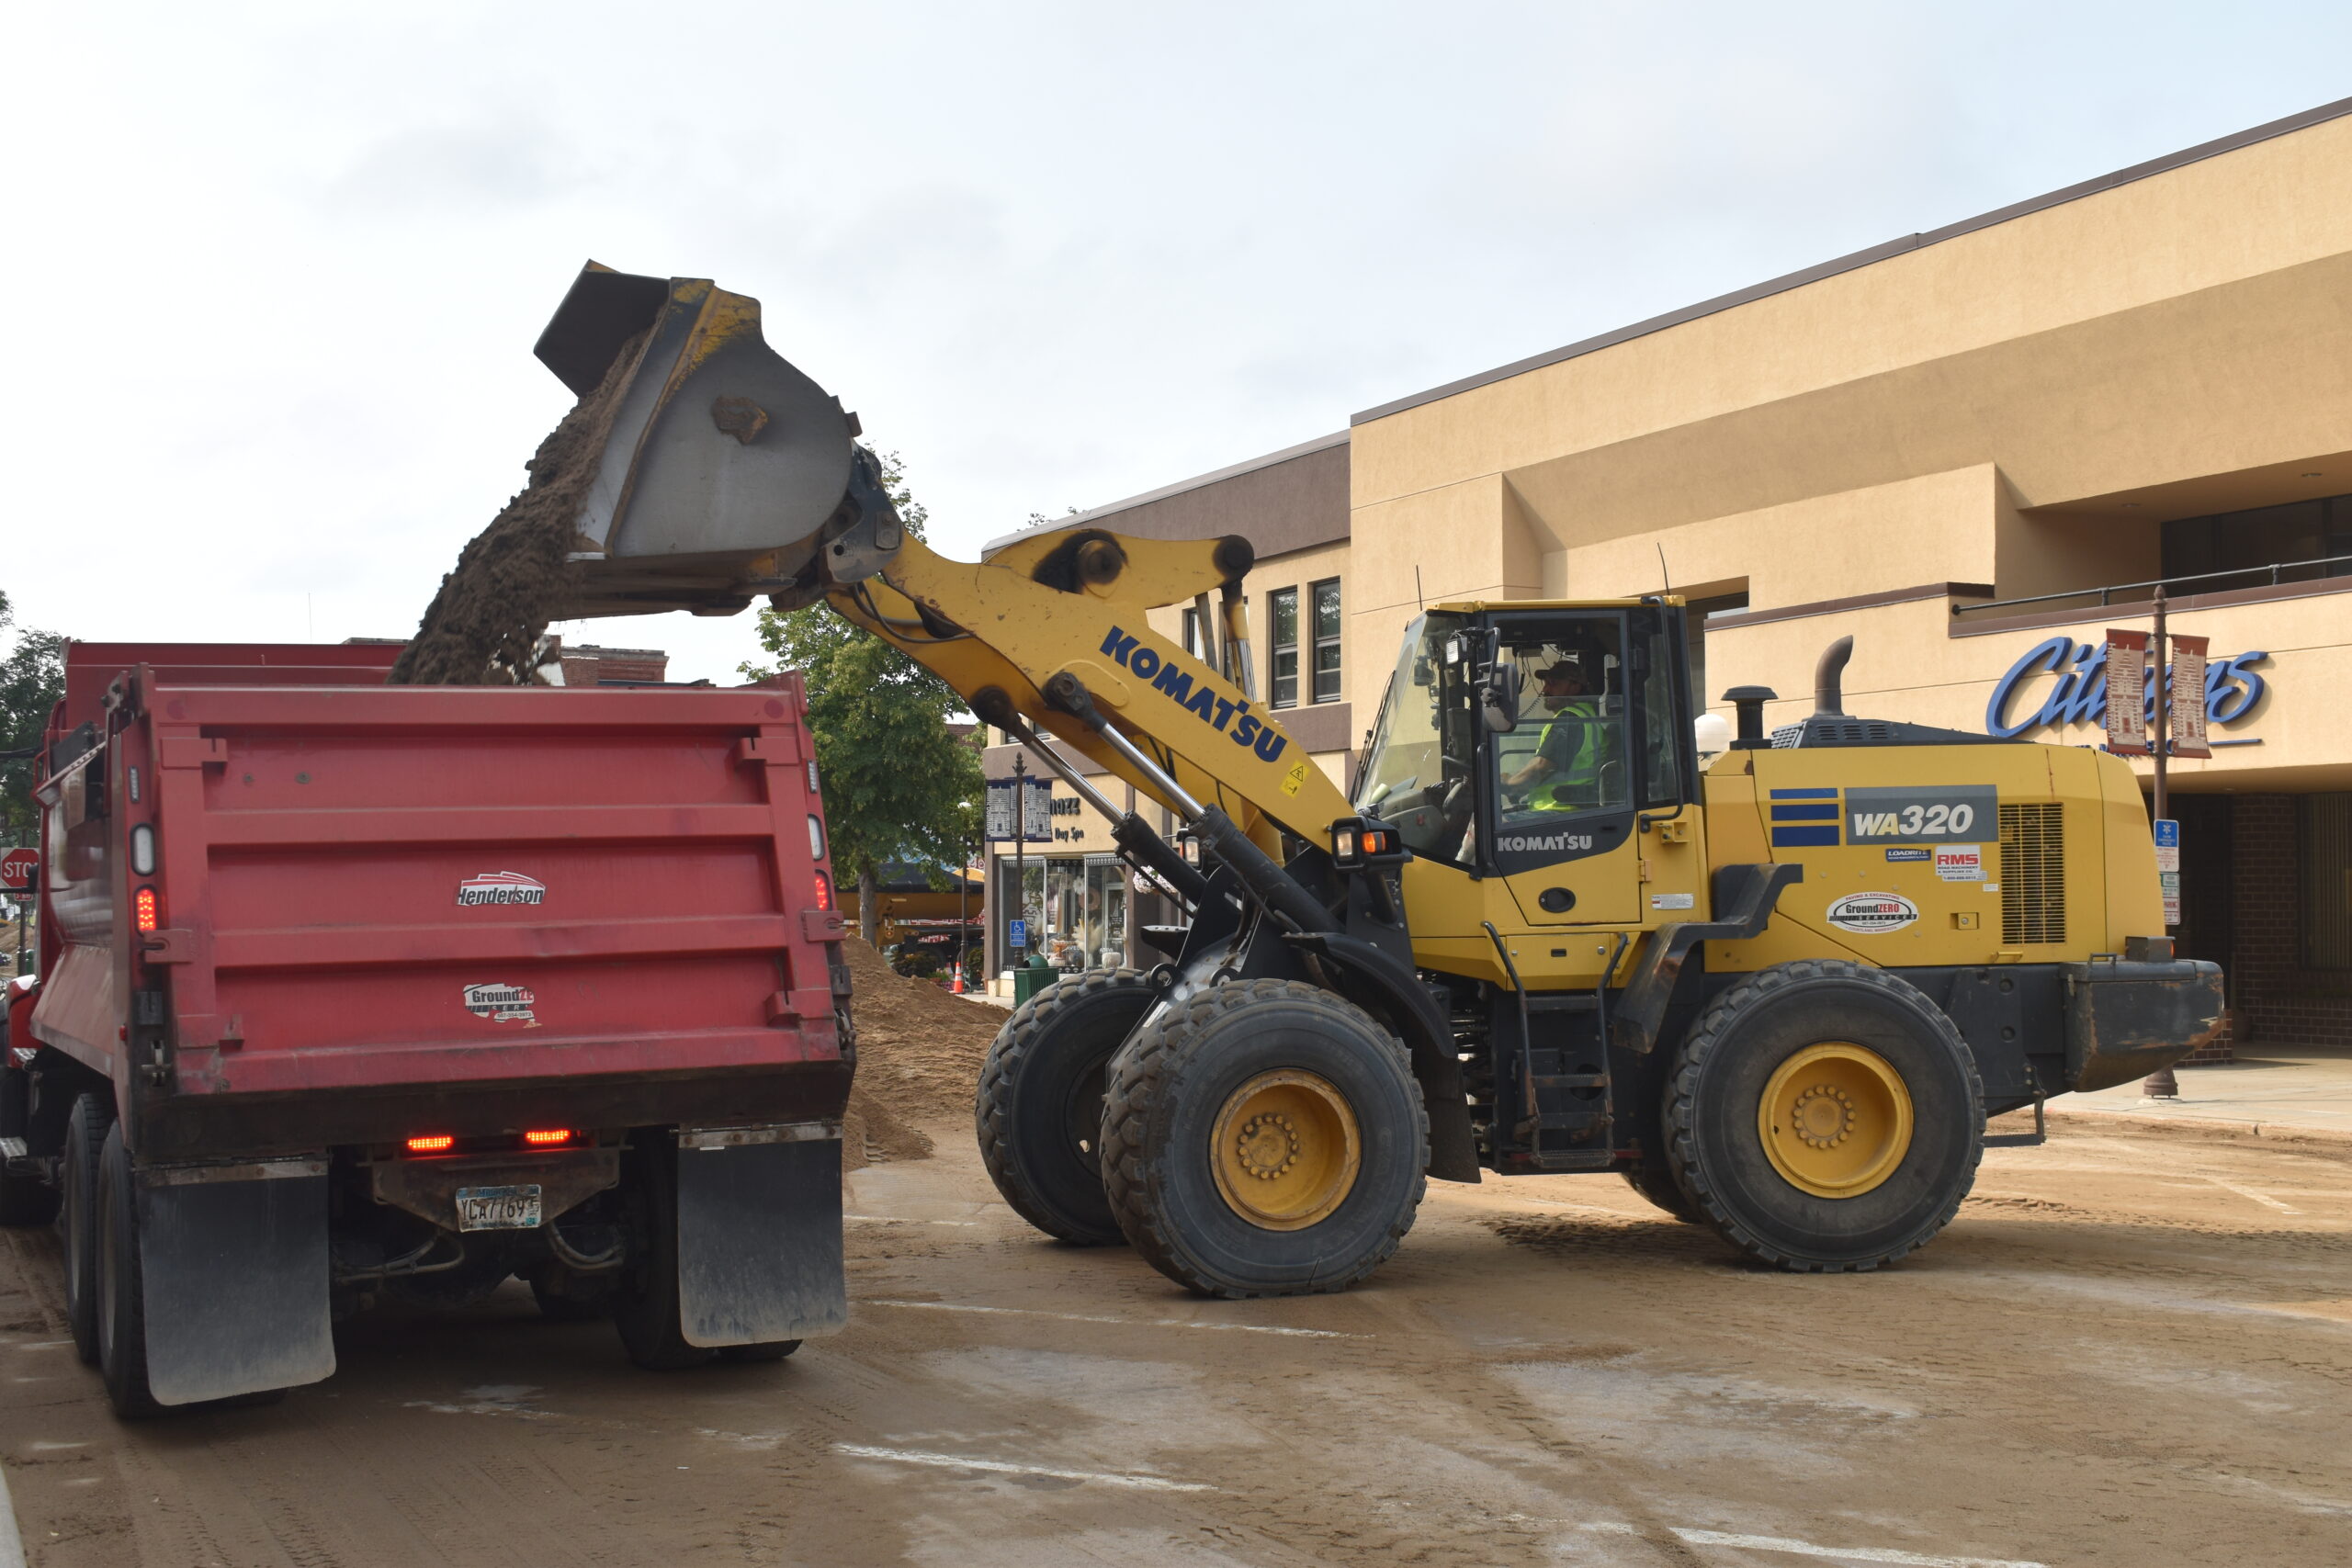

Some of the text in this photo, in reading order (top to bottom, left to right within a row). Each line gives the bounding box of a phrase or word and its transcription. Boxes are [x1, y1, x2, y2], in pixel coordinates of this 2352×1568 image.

[1100, 625, 1287, 762] KOMATSU
[1854, 804, 1973, 836] WA320
[1055, 827, 1084, 842] Day Spa
[1498, 831, 1592, 852] KOMATSU
[1937, 854, 1978, 864] RMS
[4, 862, 38, 878] STO
[458, 886, 544, 905] Henderson
[1846, 904, 1900, 913] GroundZERO
